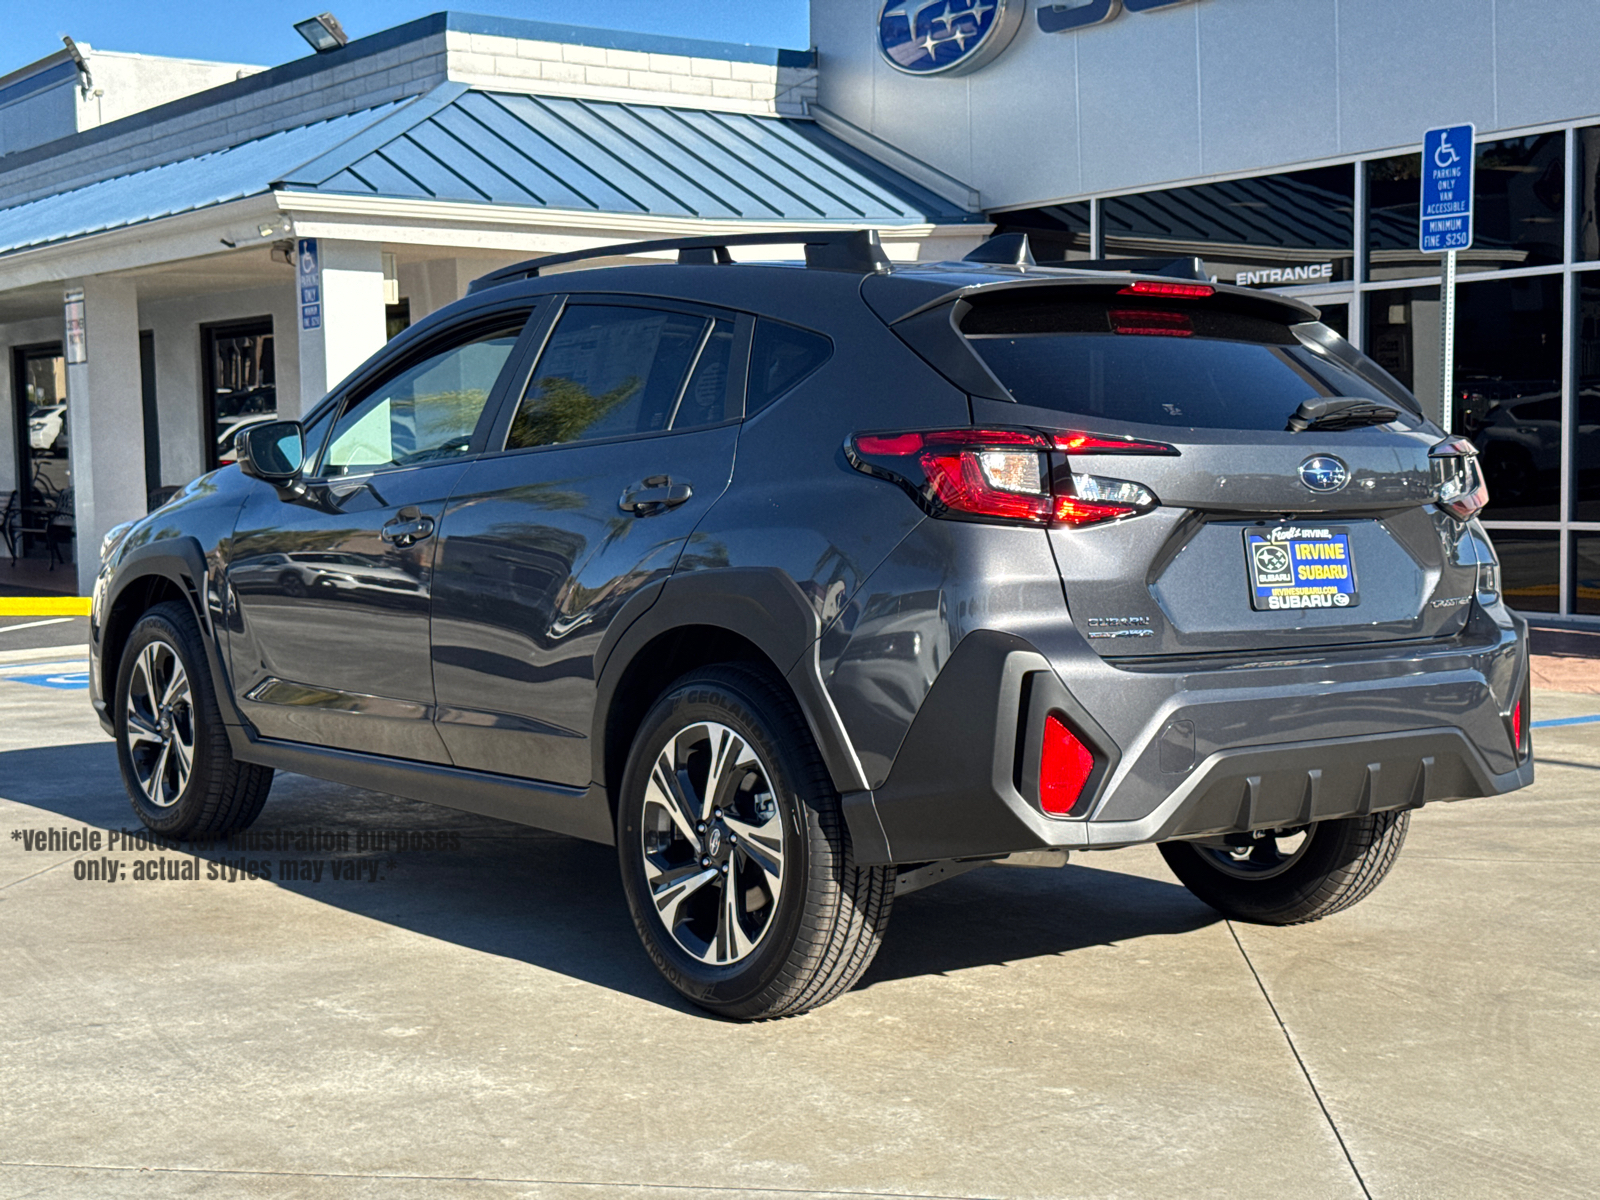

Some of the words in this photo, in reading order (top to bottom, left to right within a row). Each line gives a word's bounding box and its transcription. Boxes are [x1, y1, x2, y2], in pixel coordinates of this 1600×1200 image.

[1433, 167, 1461, 179] PARKING
[1438, 180, 1455, 190] ONLY
[1440, 191, 1453, 201] VAN
[1427, 201, 1466, 214] ACCESSIBLE
[1430, 219, 1462, 232] MINIMUM
[1424, 235, 1440, 247] FINE
[1446, 232, 1467, 246] $250
[1236, 263, 1333, 286] ENTRANCE
[1302, 529, 1330, 539] IRVINE
[1295, 543, 1346, 560] IRVINE
[1259, 574, 1291, 583] SUBARU
[1298, 565, 1348, 580] SUBARU
[1268, 595, 1333, 609] SUBARU
